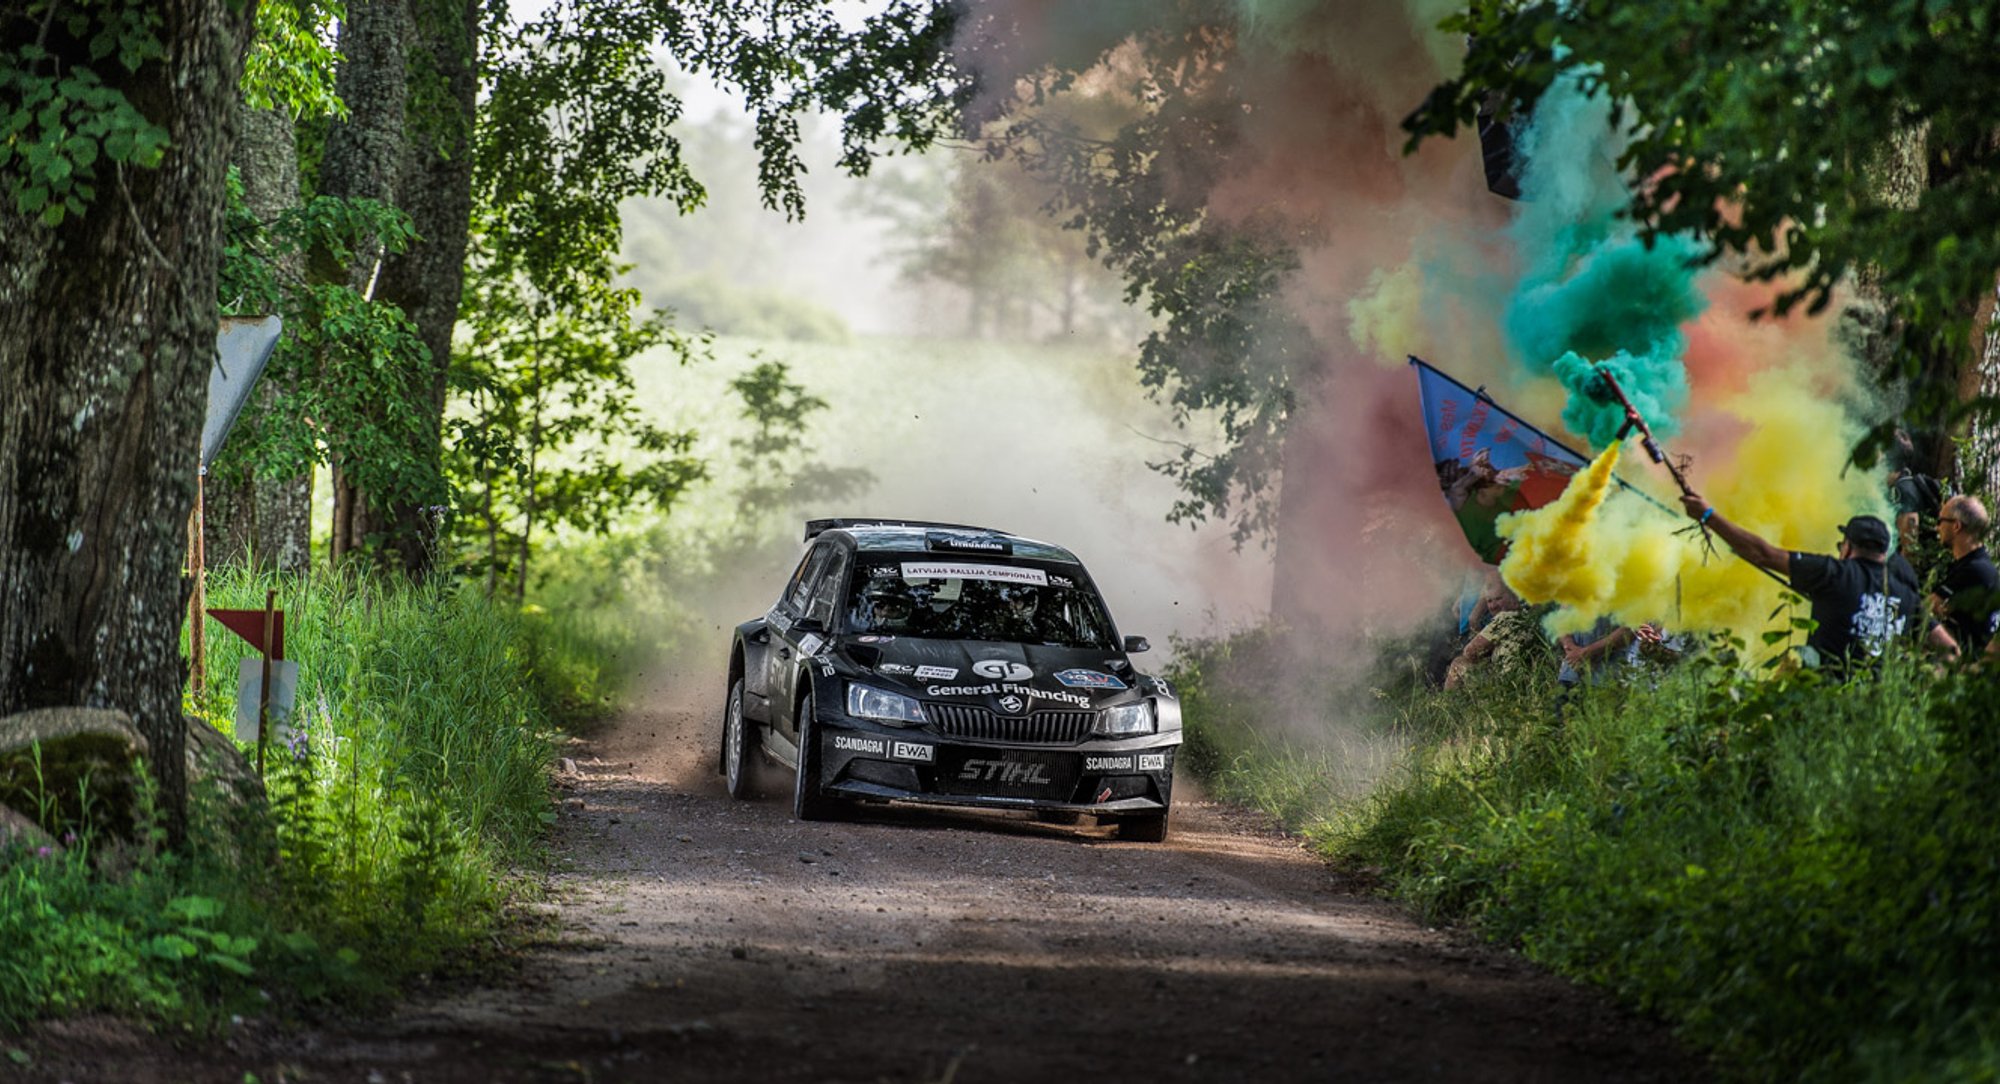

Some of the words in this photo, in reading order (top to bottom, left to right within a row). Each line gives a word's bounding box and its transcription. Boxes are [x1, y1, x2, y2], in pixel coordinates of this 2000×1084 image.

[950, 540, 1003, 550] LITHUANIAN
[907, 567, 948, 575] LATVIJAS
[950, 568, 986, 576] RALLIJA
[926, 683, 1000, 696] General
[1002, 683, 1091, 709] Financing
[834, 736, 884, 754] SCANDAGRA
[897, 744, 928, 758] EWA
[958, 758, 1051, 784] STIHL
[1086, 756, 1132, 770] SCANDAGRA
[1141, 755, 1163, 768] EWA
